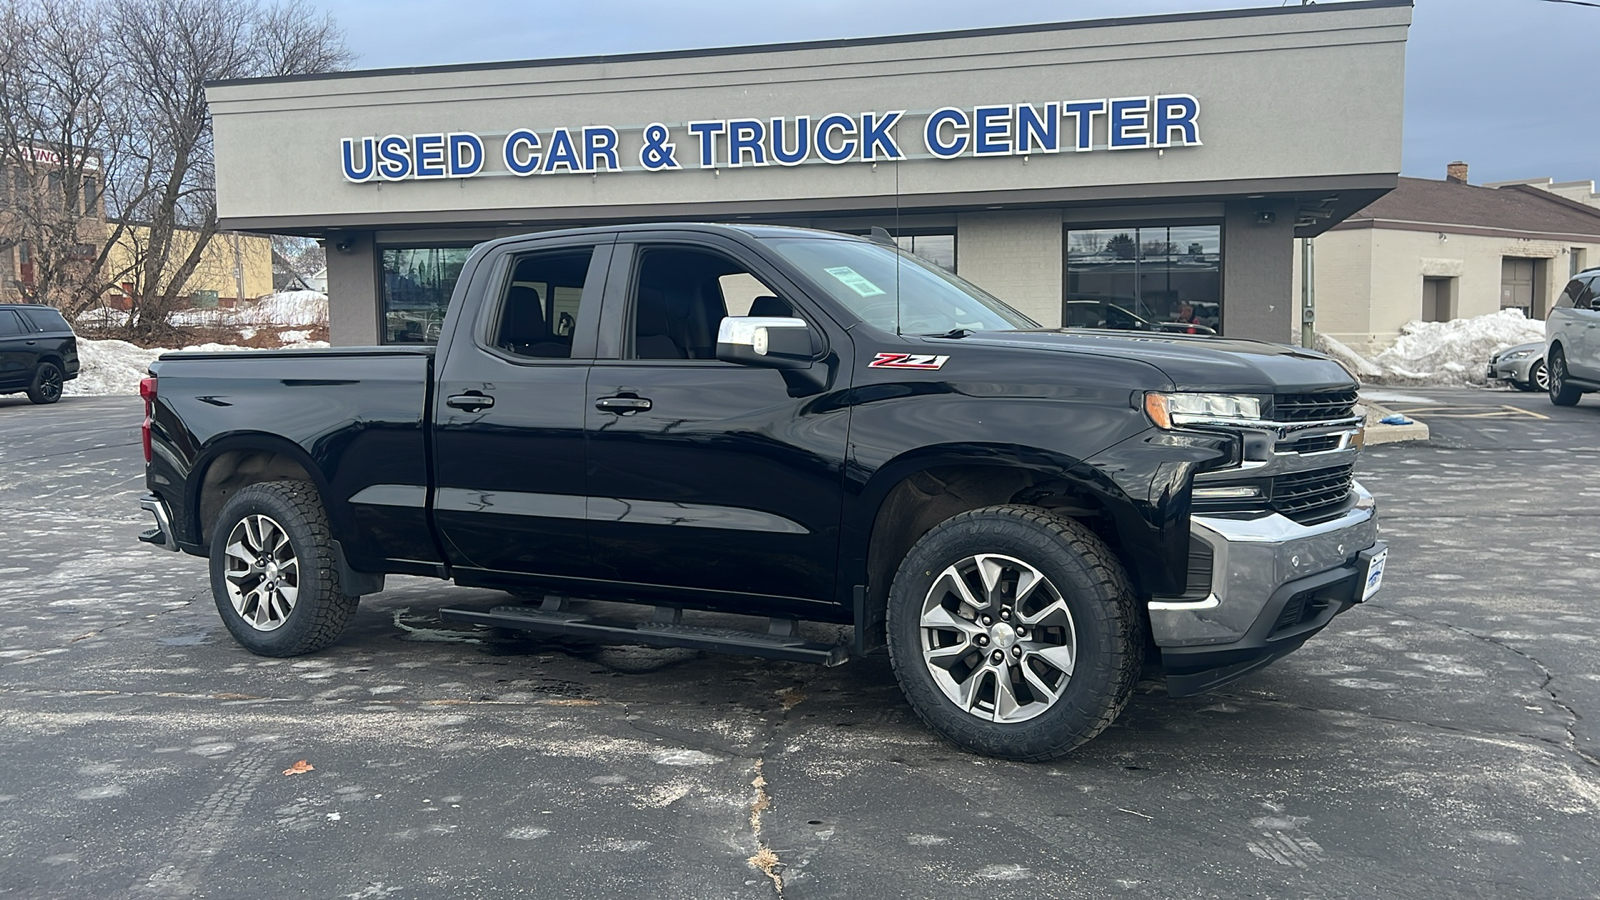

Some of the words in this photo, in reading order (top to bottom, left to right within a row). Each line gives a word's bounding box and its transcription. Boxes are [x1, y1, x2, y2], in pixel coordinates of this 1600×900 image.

[340, 131, 486, 183] USED
[502, 125, 623, 177] CAR
[638, 122, 683, 172] &
[688, 109, 907, 170] TRUCK
[924, 93, 1204, 159] CENTER
[867, 353, 951, 370] Z71
